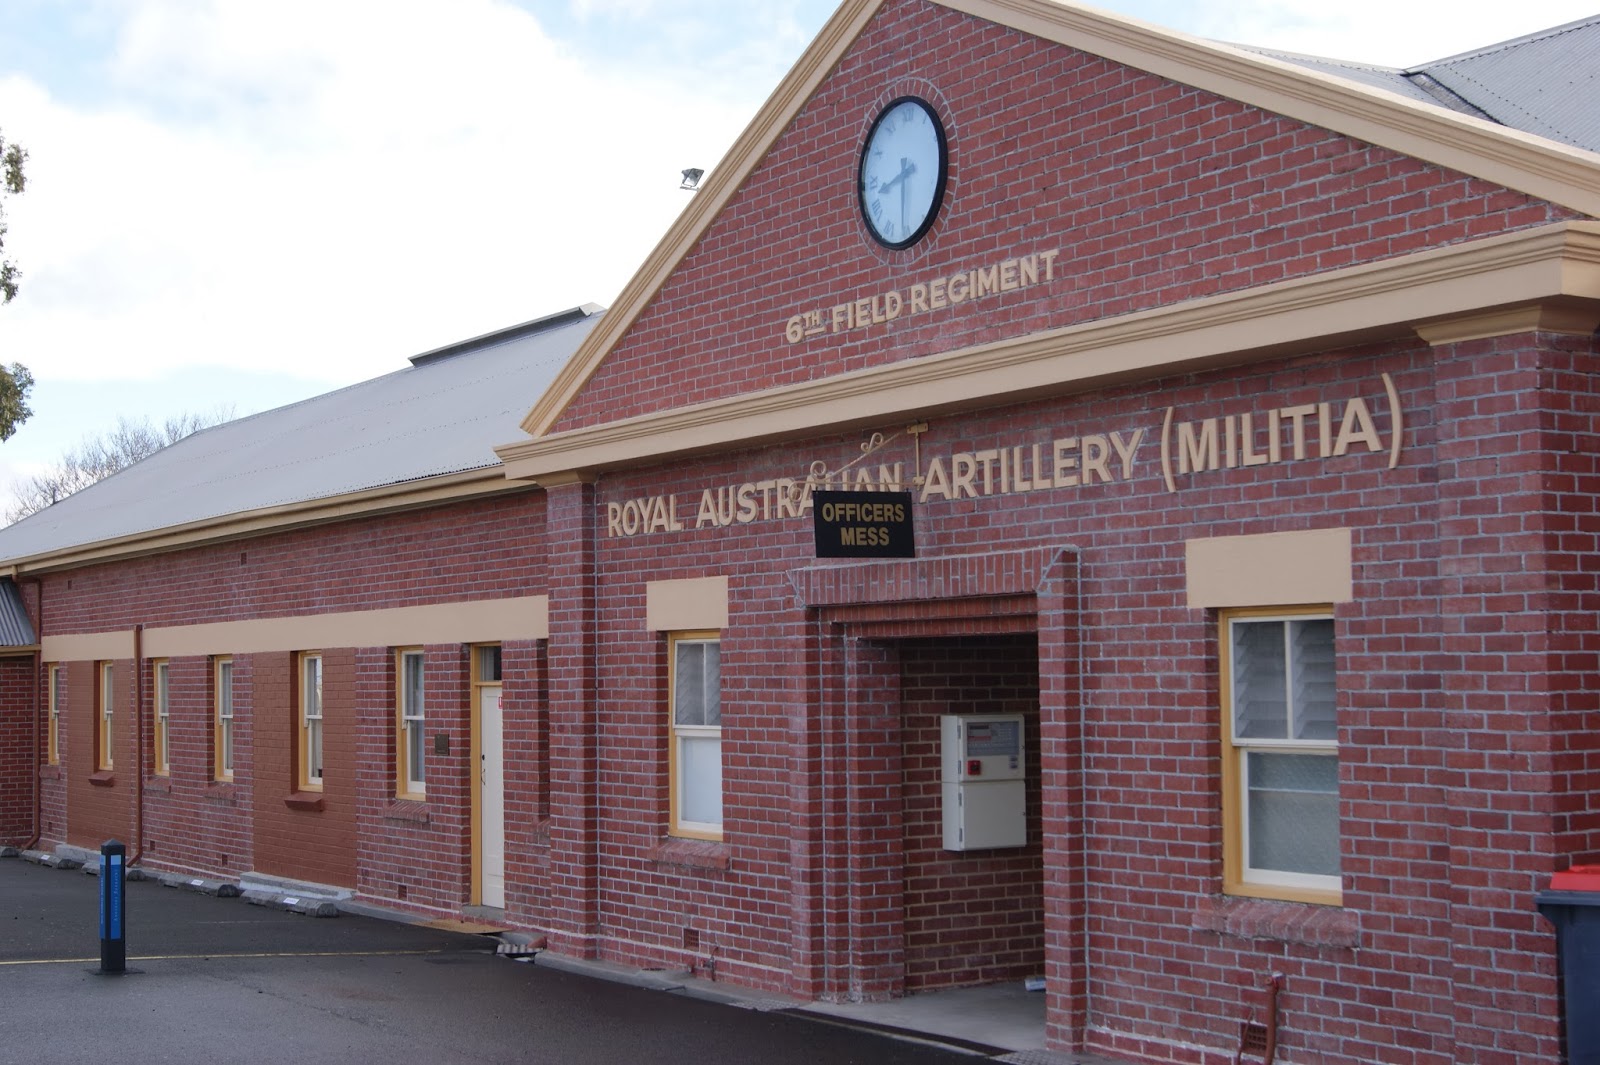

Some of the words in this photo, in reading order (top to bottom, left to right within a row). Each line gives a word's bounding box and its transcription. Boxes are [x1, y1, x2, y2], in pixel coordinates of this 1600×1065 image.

[831, 291, 904, 333] FIELD
[910, 249, 1060, 315] REGIMENT
[607, 494, 684, 538] ROYAL
[920, 428, 1148, 503] ARTILLERY
[1161, 373, 1403, 493] (MILITIA)
[821, 502, 905, 523] OFFICERS
[840, 527, 890, 547] MESS
